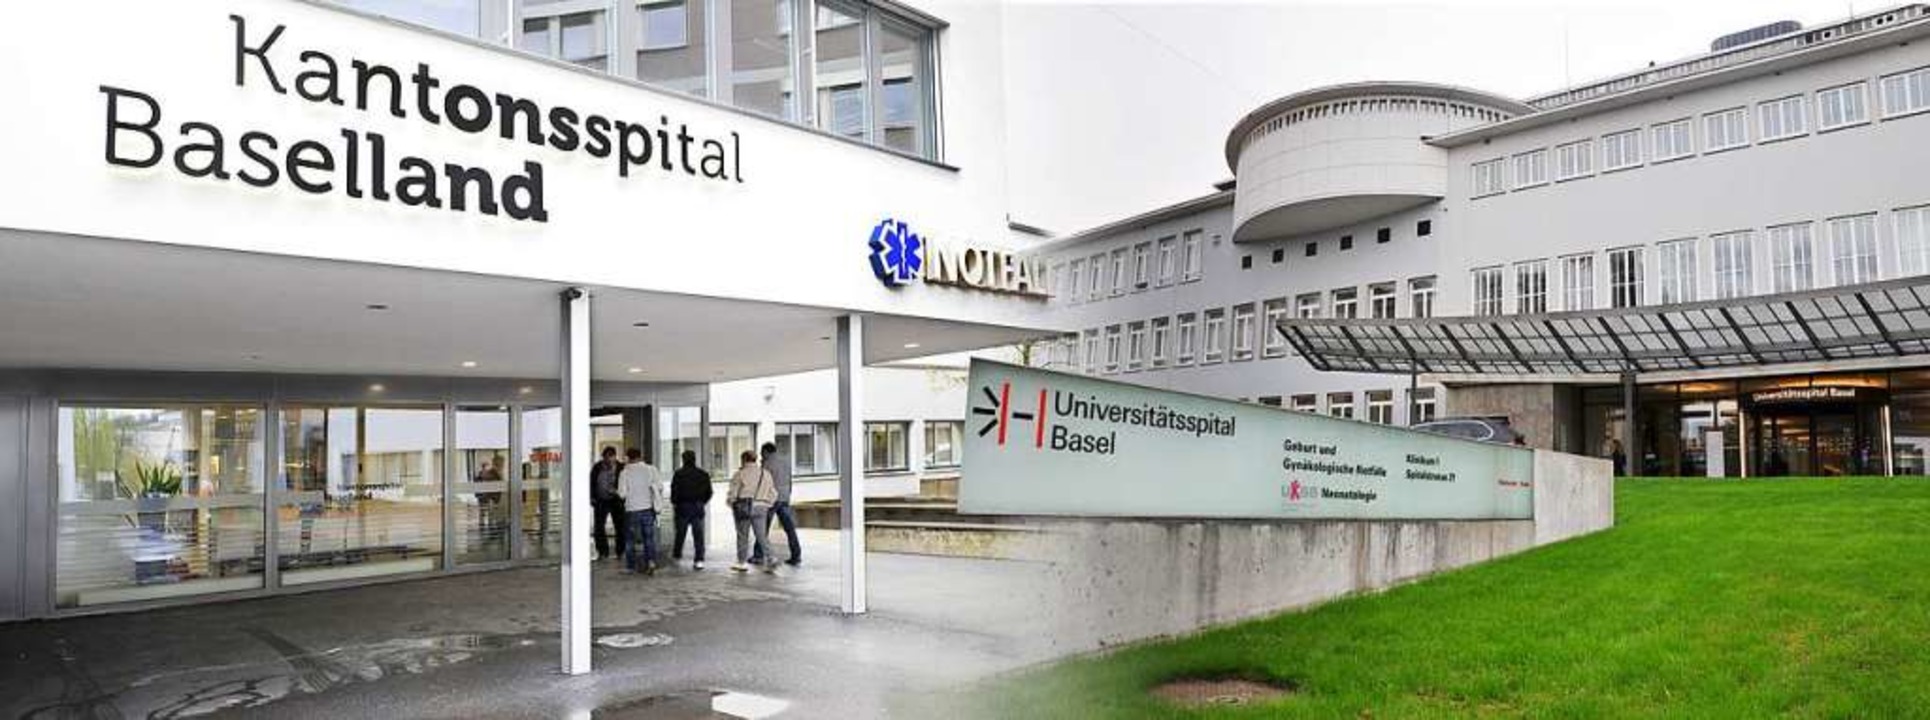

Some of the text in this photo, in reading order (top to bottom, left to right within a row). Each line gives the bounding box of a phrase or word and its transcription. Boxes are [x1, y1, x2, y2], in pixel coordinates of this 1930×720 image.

[229, 15, 744, 183] Kantonsspital
[99, 84, 548, 222] Baselland
[1054, 390, 1236, 437] Universitätsspital
[1051, 424, 1116, 455] Basel
[1283, 439, 1336, 455] Geburt und
